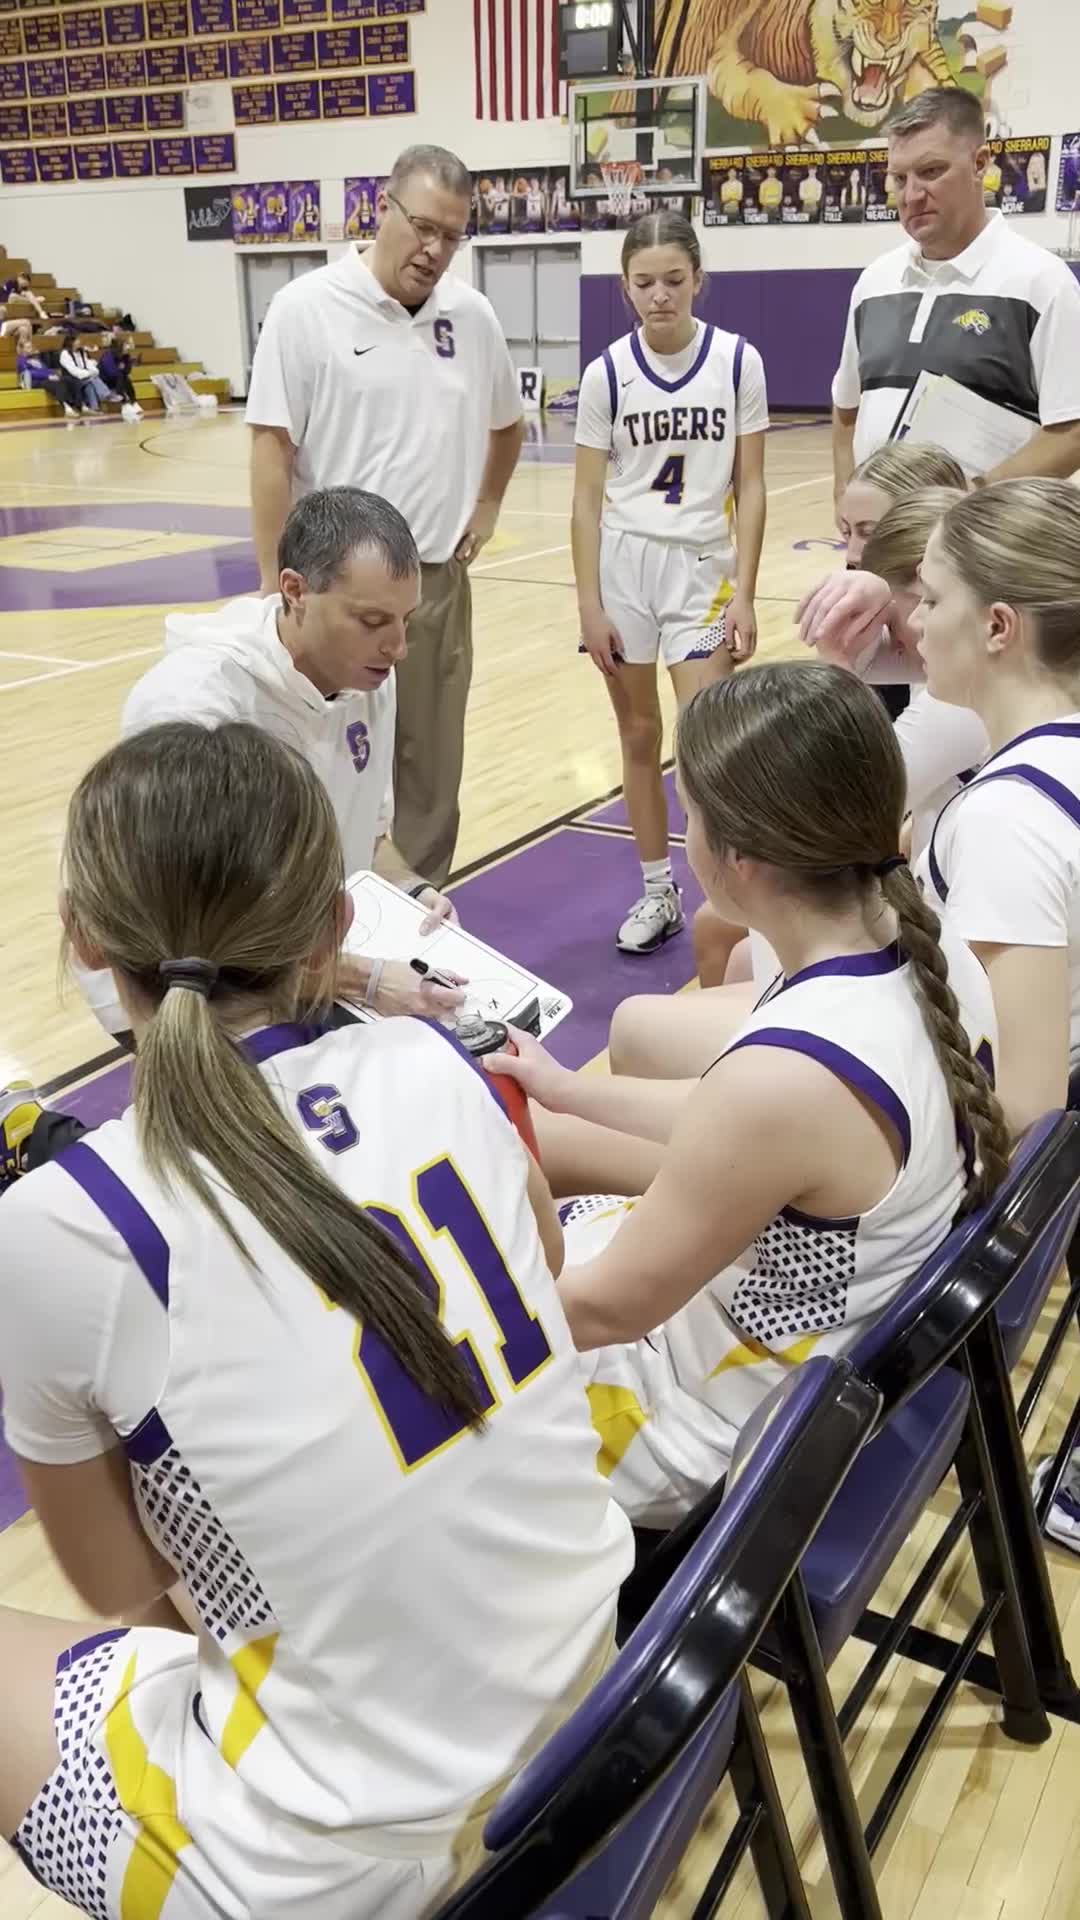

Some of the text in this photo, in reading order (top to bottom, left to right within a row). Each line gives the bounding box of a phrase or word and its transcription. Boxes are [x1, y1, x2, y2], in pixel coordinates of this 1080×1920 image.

[827, 151, 866, 165] SHERRARD
[869, 151, 888, 162] SHER
[1005, 137, 1049, 152] SHERRARD
[433, 319, 456, 359] S
[521, 371, 537, 401] R
[623, 407, 727, 446] TIGERS
[651, 455, 686, 505] 4
[346, 720, 370, 774] S
[296, 1083, 360, 1155] S
